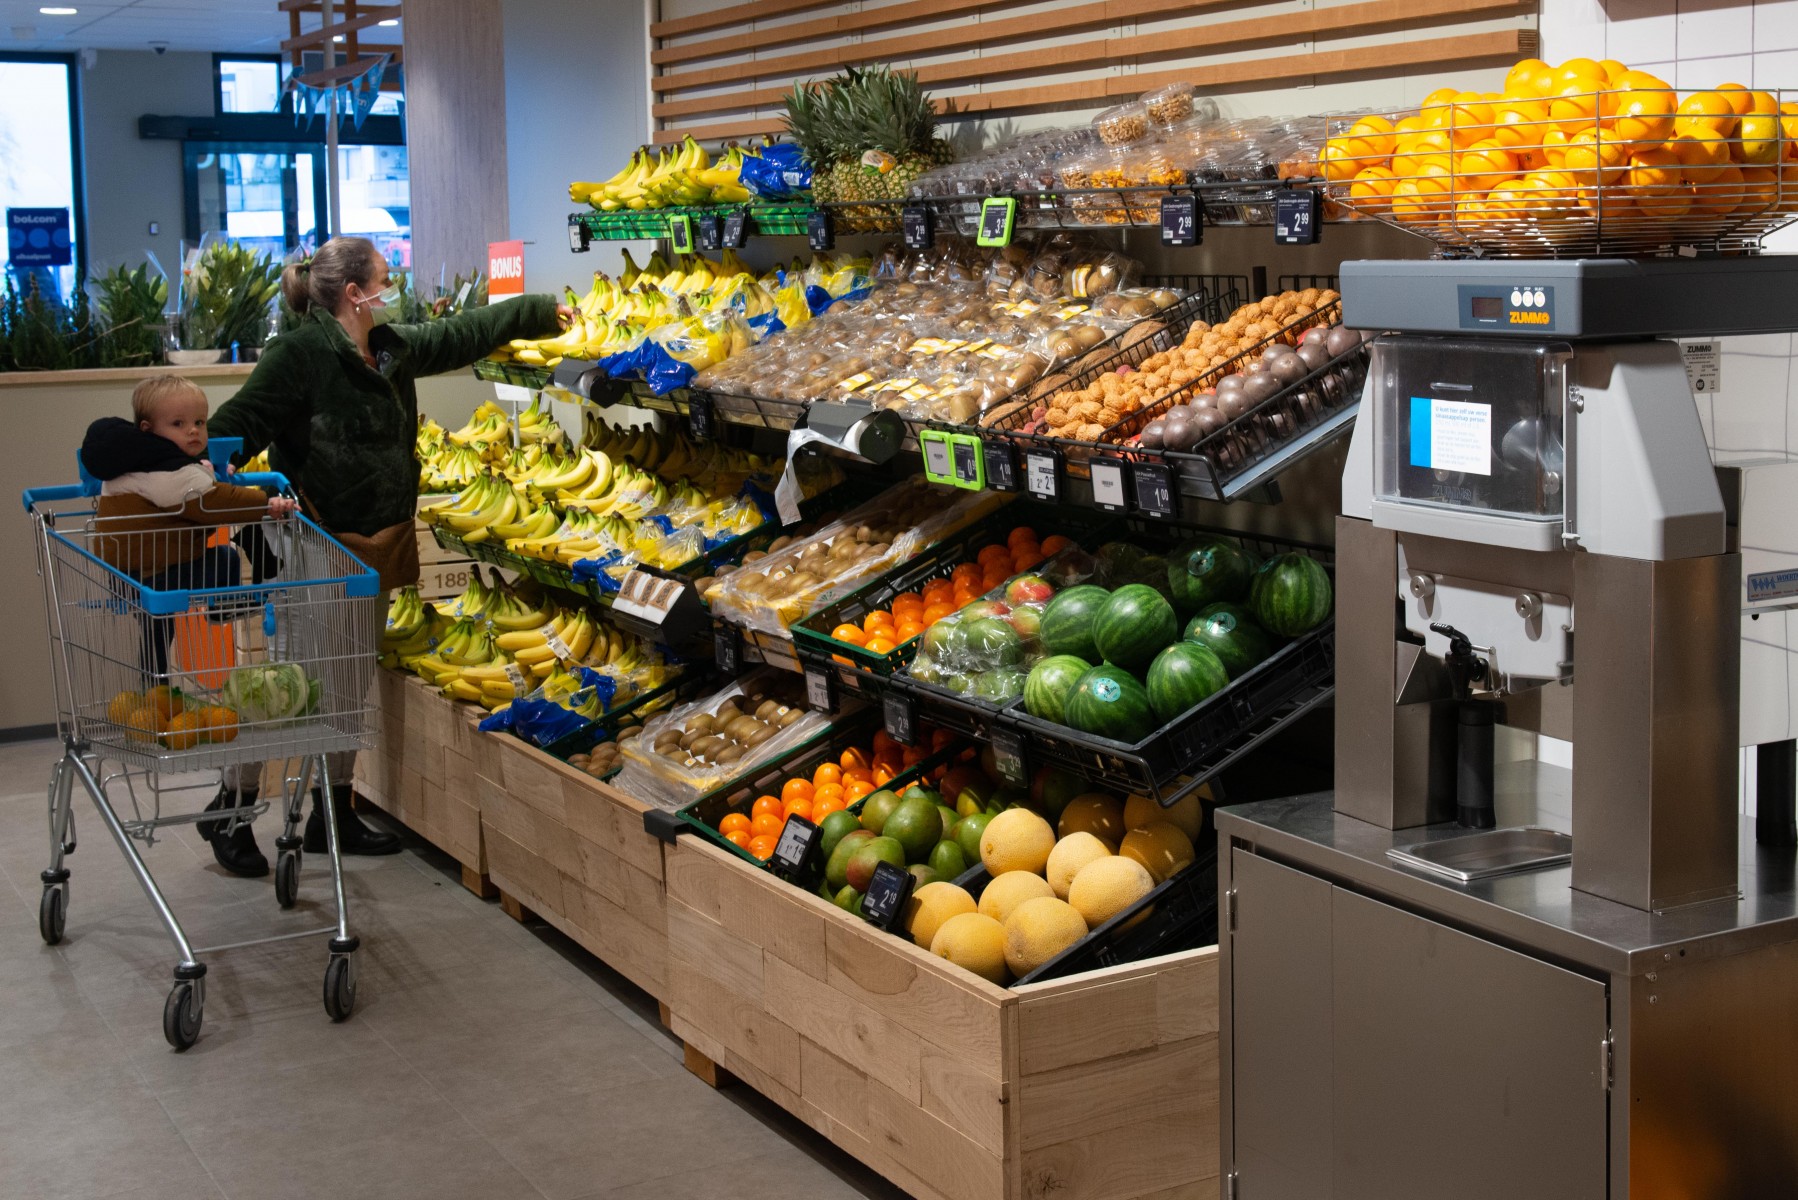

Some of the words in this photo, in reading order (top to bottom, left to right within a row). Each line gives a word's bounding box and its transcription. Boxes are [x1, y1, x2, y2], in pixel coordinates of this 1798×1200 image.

[13, 214, 57, 224] bol.com
[1178, 216, 1192, 235] 2.99
[1294, 212, 1309, 232] 2.99
[490, 255, 522, 280] BONUS
[1509, 311, 1550, 325] ZUMMO
[1686, 344, 1712, 353] ZUMMO
[434, 571, 471, 590] 188
[879, 889, 897, 909] 2.19
